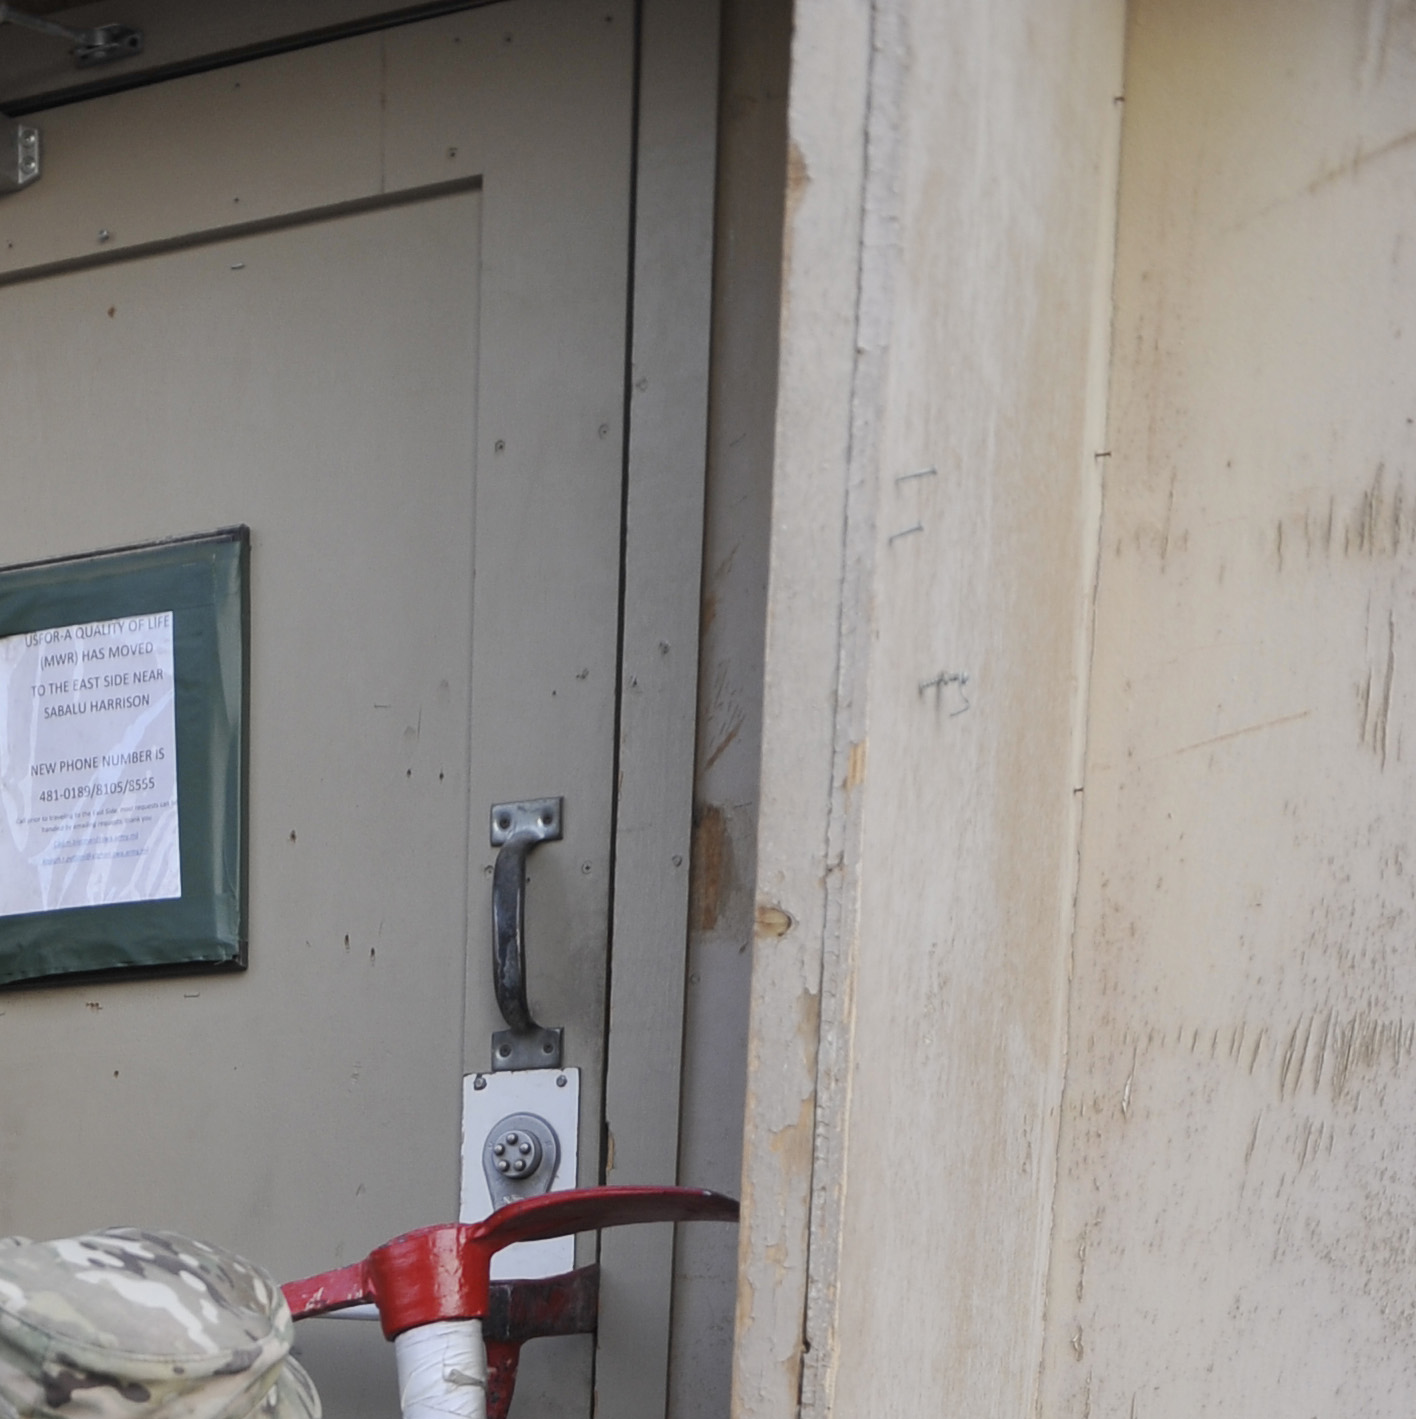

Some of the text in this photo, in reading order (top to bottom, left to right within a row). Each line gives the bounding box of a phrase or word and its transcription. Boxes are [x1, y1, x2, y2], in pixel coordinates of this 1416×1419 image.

[24, 614, 170, 648] USFOR-A QUALITY OF LIFE
[40, 641, 154, 672] (MWR) HAS MOVED
[31, 668, 164, 697] TO THE EAST SIDE NEAR
[44, 693, 151, 719] SABALU HARRISON
[31, 747, 166, 777] NEW PHONE NUMBER IS
[39, 776, 156, 803] 481-0189/8105/8555
